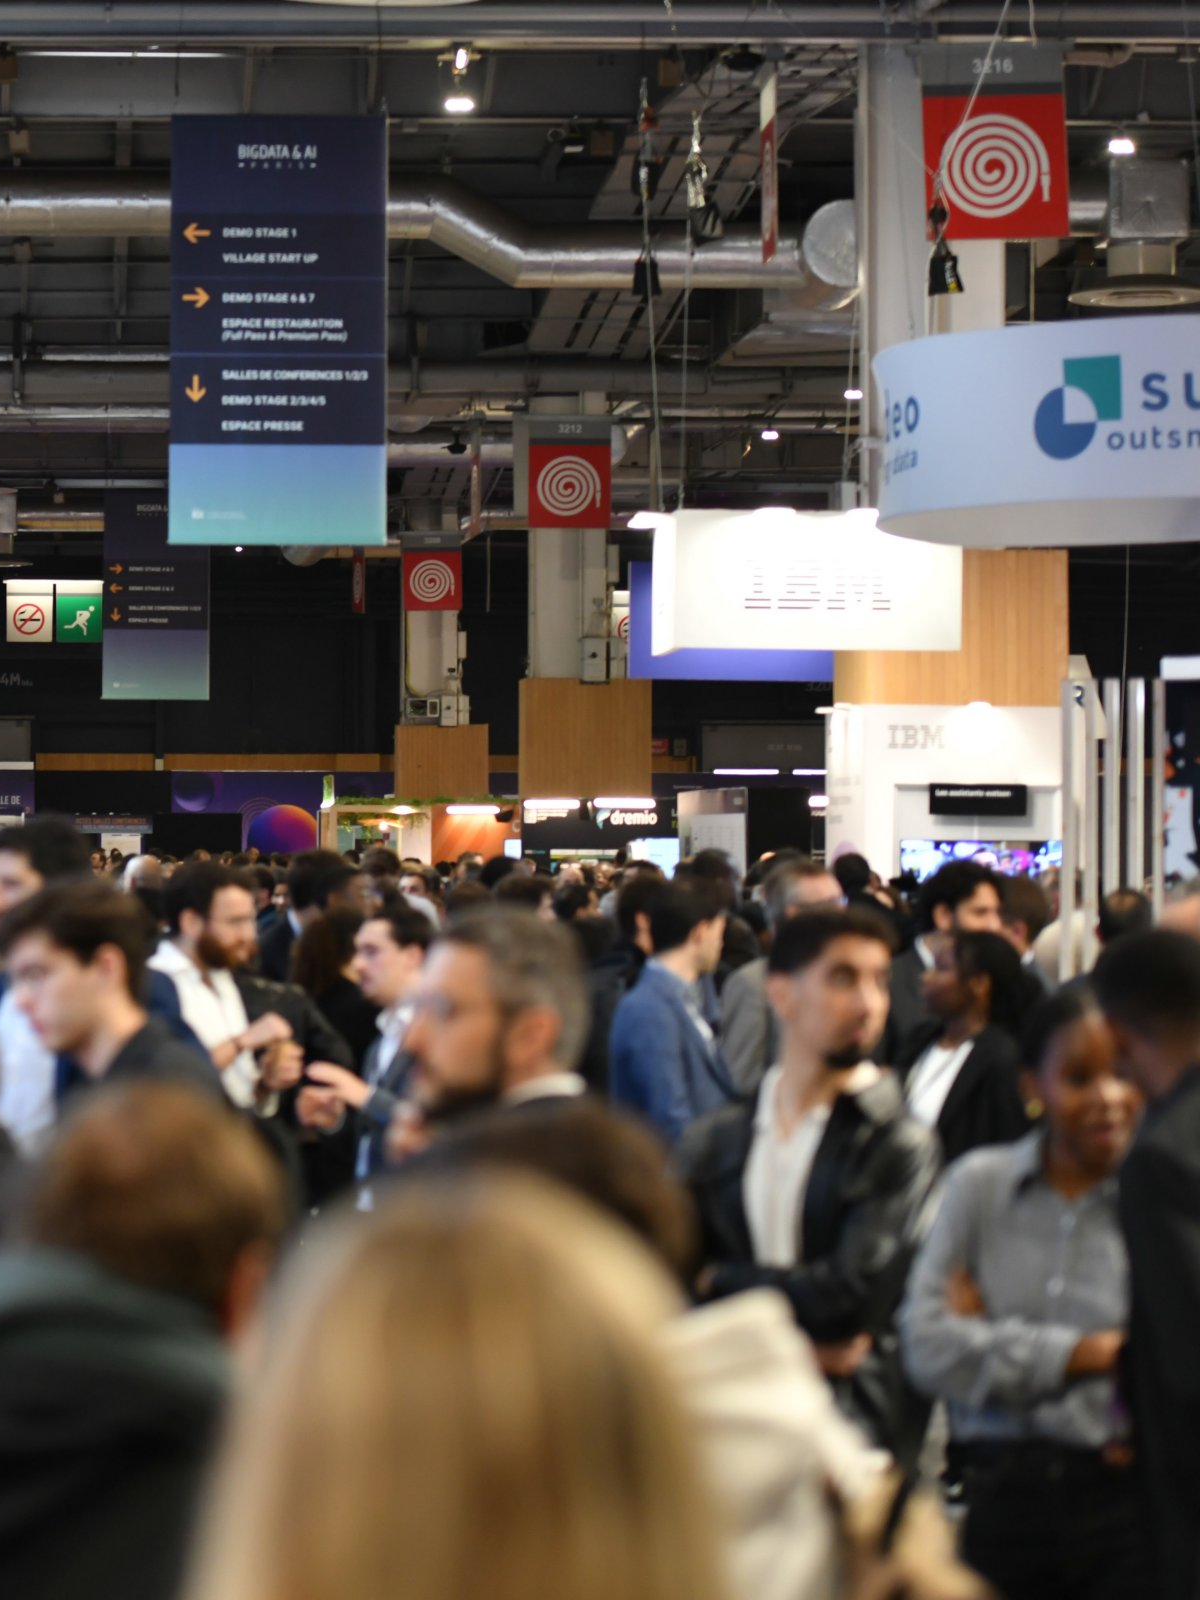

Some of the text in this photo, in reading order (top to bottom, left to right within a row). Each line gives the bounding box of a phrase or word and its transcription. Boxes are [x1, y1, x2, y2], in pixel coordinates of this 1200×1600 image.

[972, 56, 1013, 75] 3216
[237, 144, 317, 160] BIGDATA & AI
[222, 228, 297, 238] DEMO STAGE 1
[222, 253, 318, 263] VILLAGE START UP
[222, 293, 253, 303] DEMO
[255, 293, 289, 303] STAGE
[299, 293, 307, 303] &
[308, 293, 315, 303] 7
[222, 318, 343, 328] ESPACE RESTAURATION
[222, 330, 348, 342] (Full Pass & Premium Pass)
[222, 370, 258, 380] SALLES
[259, 370, 272, 380] DE
[274, 370, 343, 380] CONFERENCES
[222, 396, 252, 406] DEMO
[254, 396, 289, 406] STAGE
[222, 421, 304, 431] ESPACE PRESSE
[557, 423, 583, 434] 3212
[888, 725, 945, 750] IBM
[10, 795, 21, 805] DE
[610, 810, 657, 826] dremio
